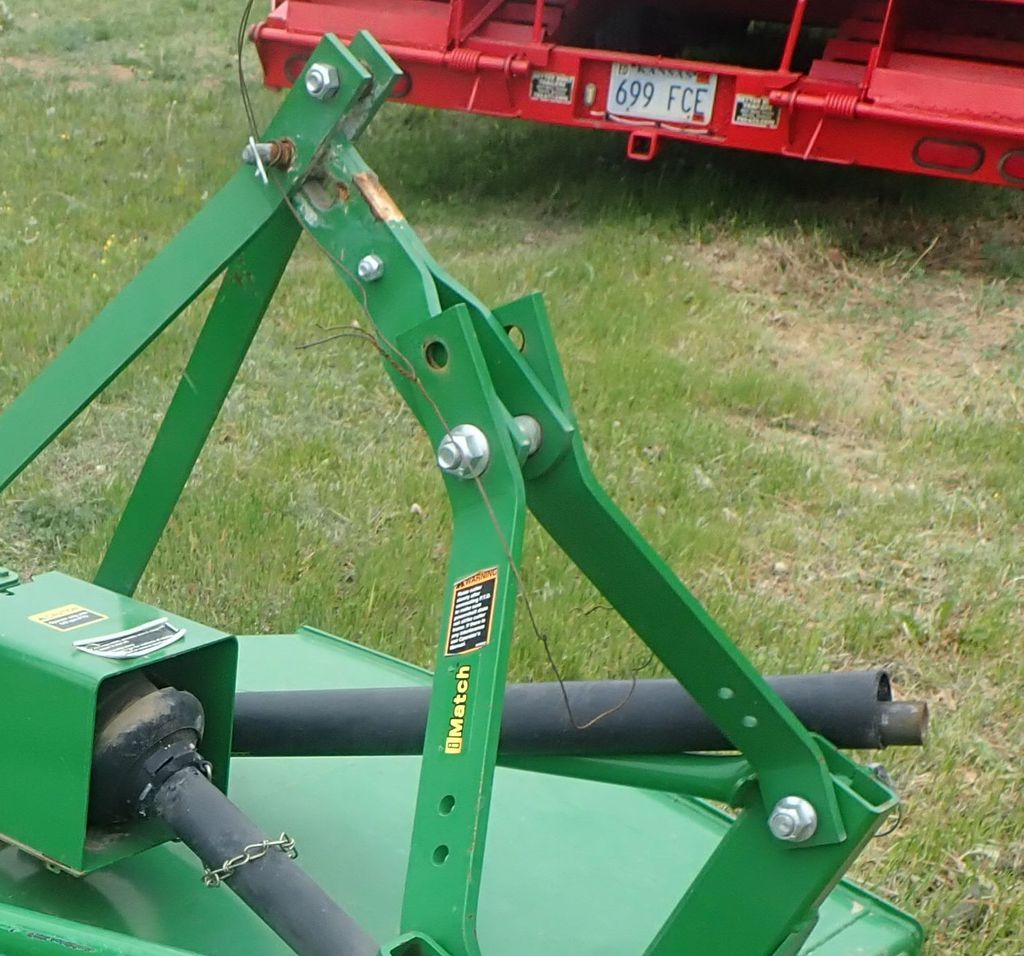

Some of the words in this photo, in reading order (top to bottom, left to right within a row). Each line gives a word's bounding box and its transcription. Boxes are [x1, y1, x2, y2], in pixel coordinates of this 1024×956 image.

[615, 79, 655, 109] 699
[667, 85, 708, 116] FCE
[444, 665, 471, 754] iMatch
